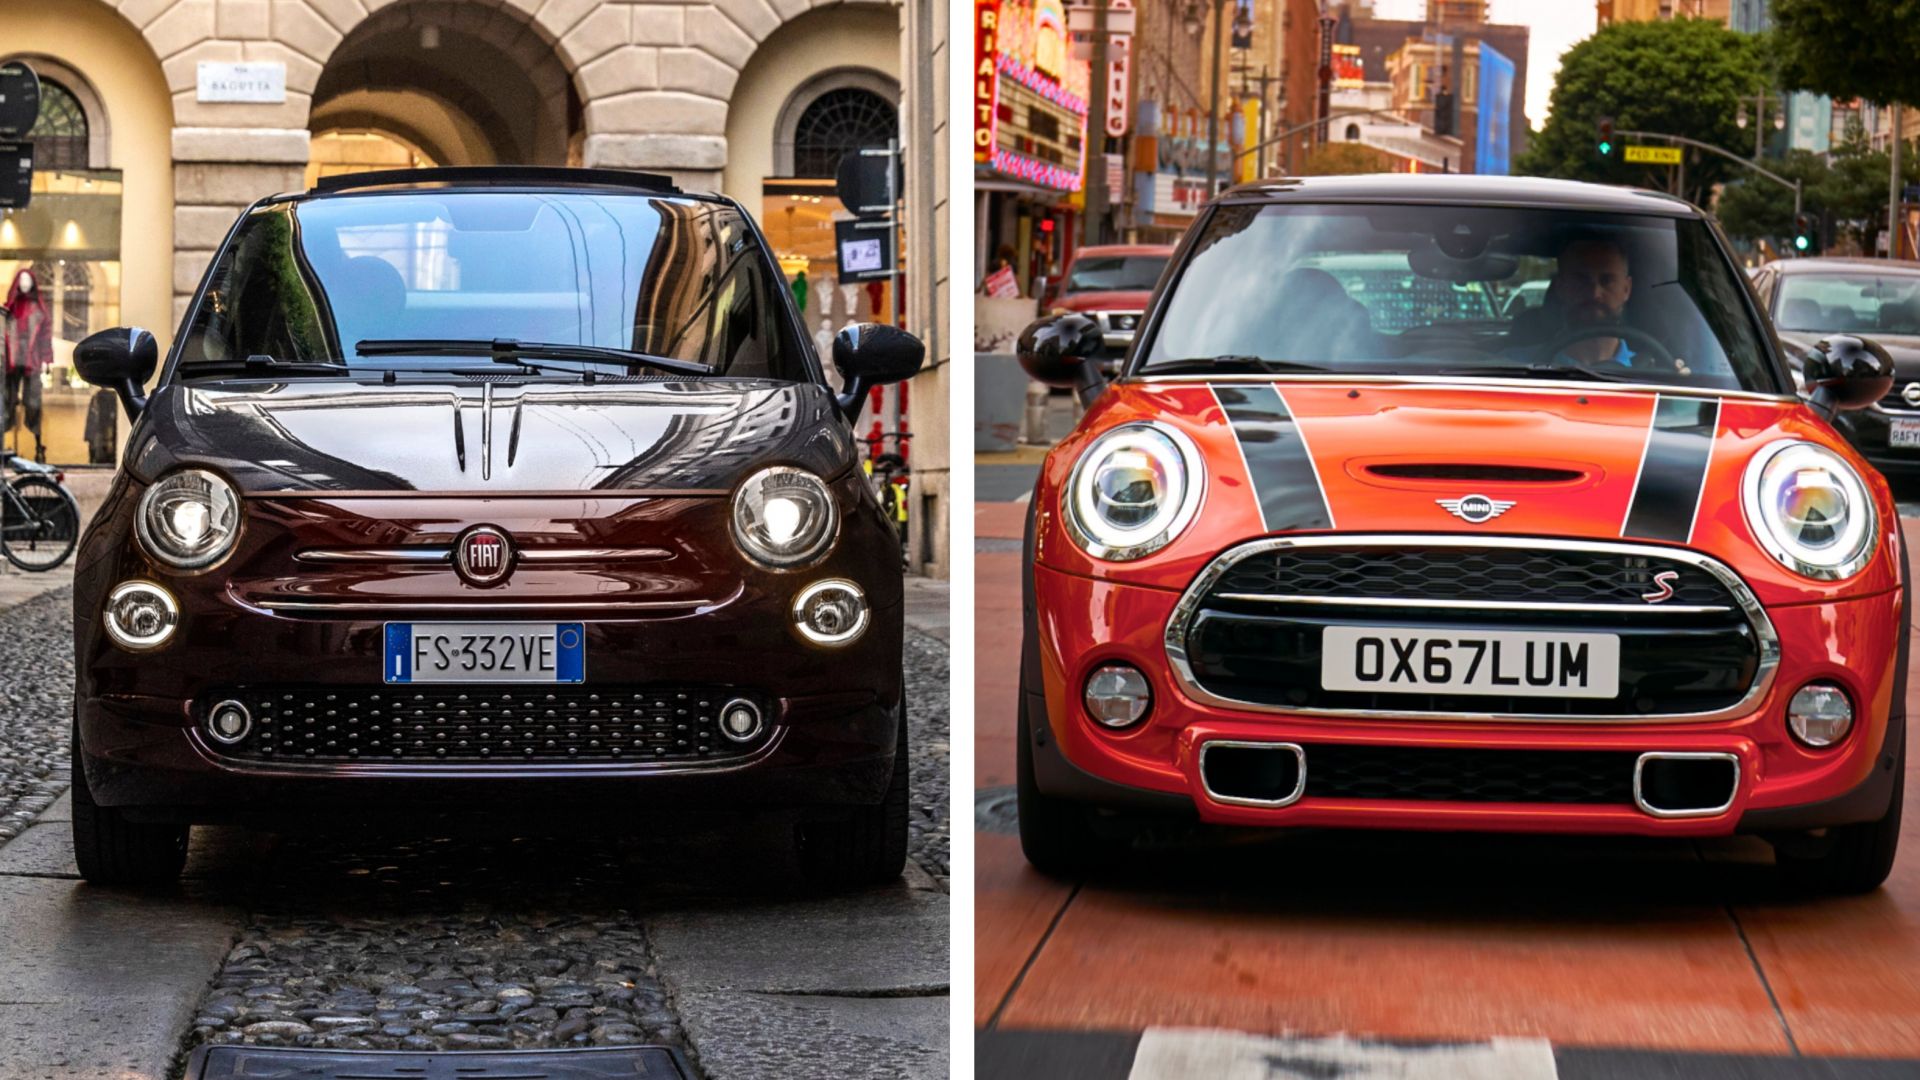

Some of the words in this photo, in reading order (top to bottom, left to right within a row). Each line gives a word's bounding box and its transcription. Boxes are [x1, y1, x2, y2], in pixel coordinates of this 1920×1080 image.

[975, 10, 996, 146] RIALTO
[1462, 503, 1490, 512] MINI
[470, 544, 500, 567] FIAT
[1641, 571, 1679, 603] S
[1355, 637, 1589, 688] OX67LUM
